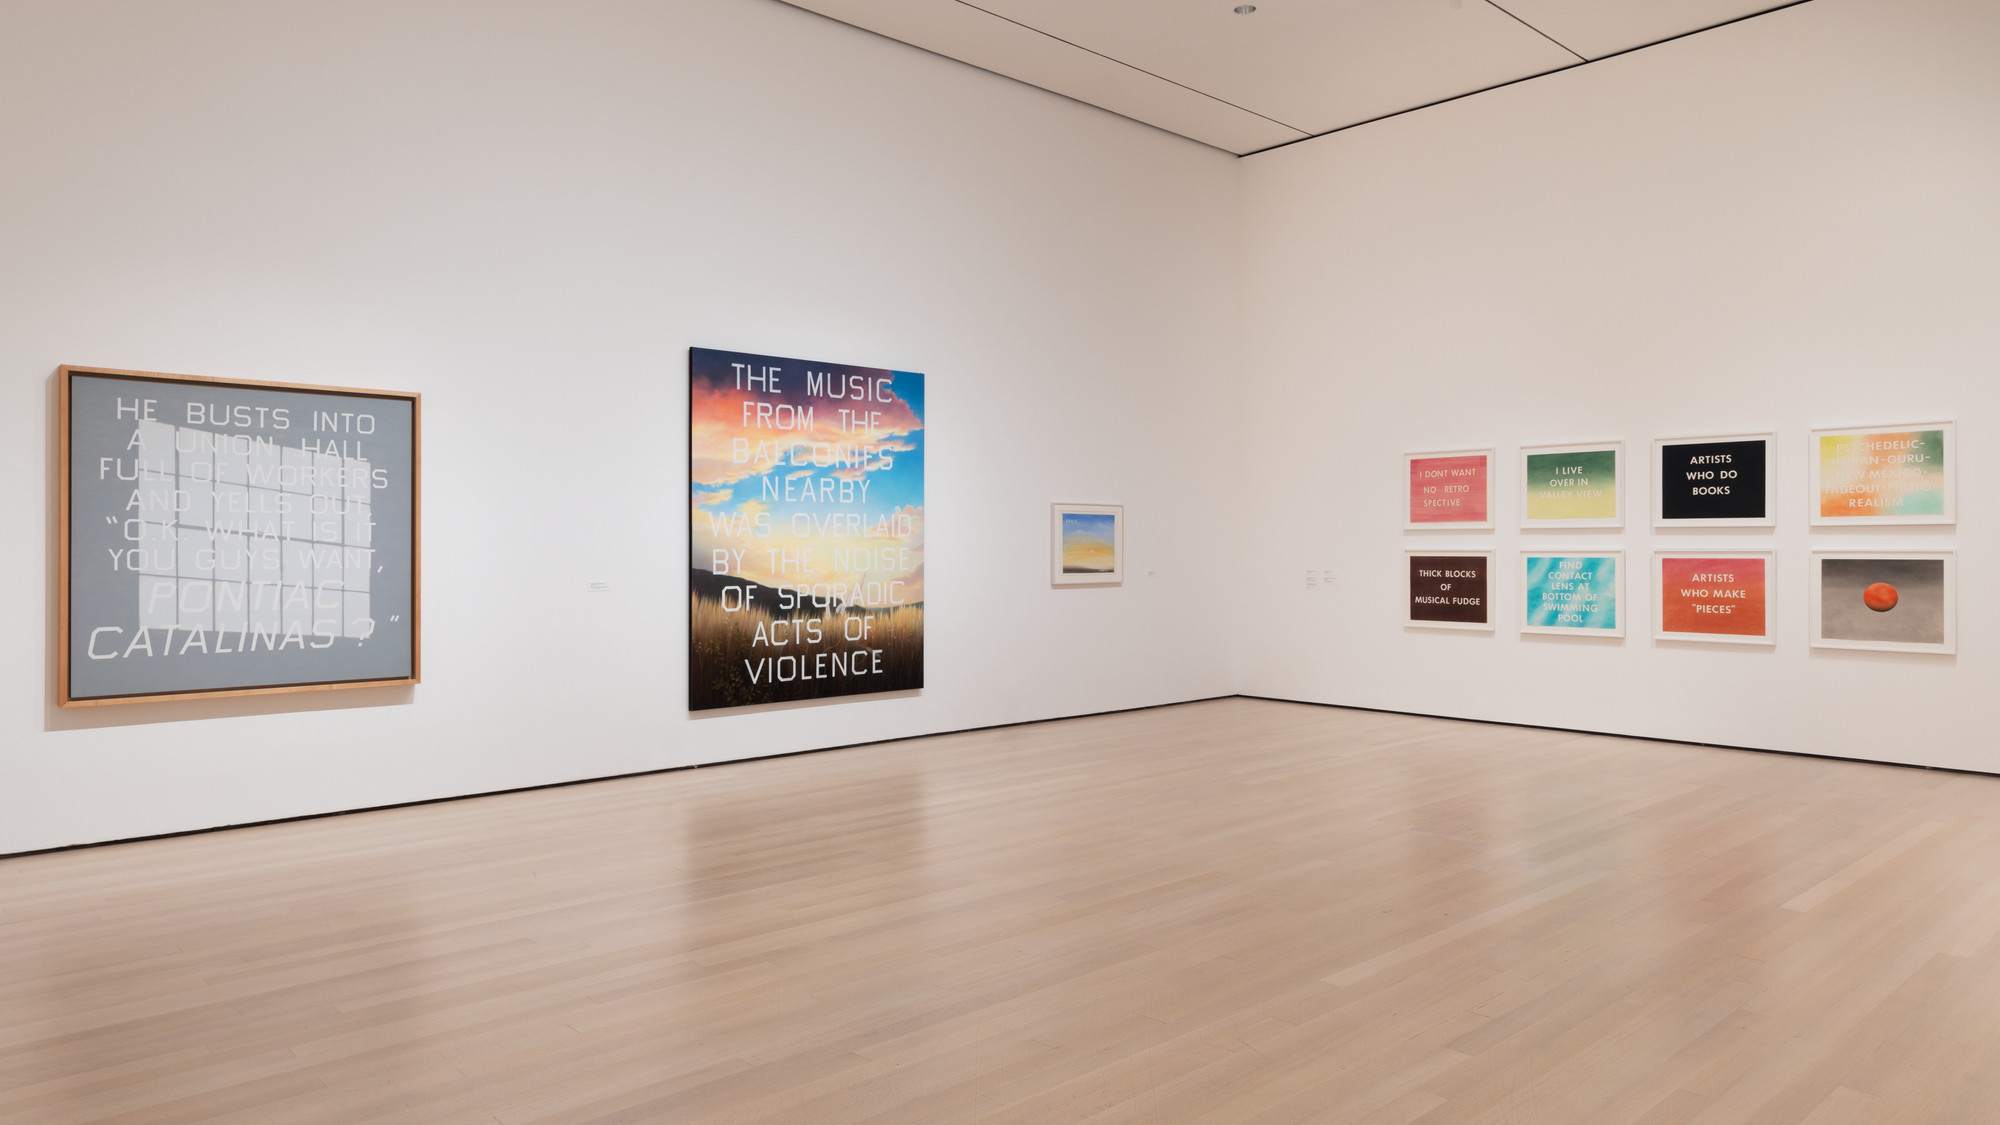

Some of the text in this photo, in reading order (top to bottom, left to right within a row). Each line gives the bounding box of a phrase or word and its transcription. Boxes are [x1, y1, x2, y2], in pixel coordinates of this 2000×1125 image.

[731, 363, 893, 404] THE MUSIC
[116, 397, 376, 435] HE BUSTS INTO
[742, 401, 882, 436] FROM THE
[127, 429, 368, 462] A UNION HALL
[732, 438, 894, 471] BALCONIES
[1690, 454, 1732, 465] ARTISTS
[100, 457, 388, 489] FULL OF WORKERS
[1419, 468, 1476, 478] I DONT WANT
[1555, 466, 1583, 475] I LIVE
[1686, 470, 1738, 481] WHO DO
[1549, 478, 1589, 487] OVER IN
[762, 476, 870, 504] NEARBY
[1423, 484, 1470, 494] NO RETRO
[1539, 489, 1603, 499] VALLEY VIEW
[1692, 485, 1730, 496] BOOKS
[125, 489, 373, 518] AND YELLS OUT,
[1423, 498, 1460, 507] SPECTIVE
[1849, 497, 1904, 508] REALISM
[709, 511, 912, 539] WAS OVERLAID
[204, 520, 295, 542] WHAT
[313, 521, 338, 542] IS
[355, 522, 377, 542] IT
[108, 549, 384, 574] YOU GUYS WANT,
[712, 546, 910, 576] BY THE NOISE
[1559, 561, 1583, 570] FIND
[1419, 569, 1476, 579] THICK BLOCKS
[1548, 571, 1593, 580] CONTACT
[1692, 573, 1734, 583] ARTISTS
[1440, 583, 1452, 592] OF
[1551, 582, 1590, 591] LENS AT
[147, 580, 345, 615] PONTIAC
[721, 580, 905, 612] OF SPORADIC
[1542, 592, 1598, 602] BOTTOM OF
[1681, 588, 1746, 599] WHO MAKE
[1414, 596, 1481, 606] MUSICAL FUDGE
[1543, 603, 1598, 613] SWIMMING
[1691, 603, 1736, 615] "PIECES"
[1557, 614, 1584, 623] POOL
[752, 616, 874, 648] ACTS OF
[87, 619, 338, 660] CATALINAS
[744, 649, 884, 685] VIOLENCE
